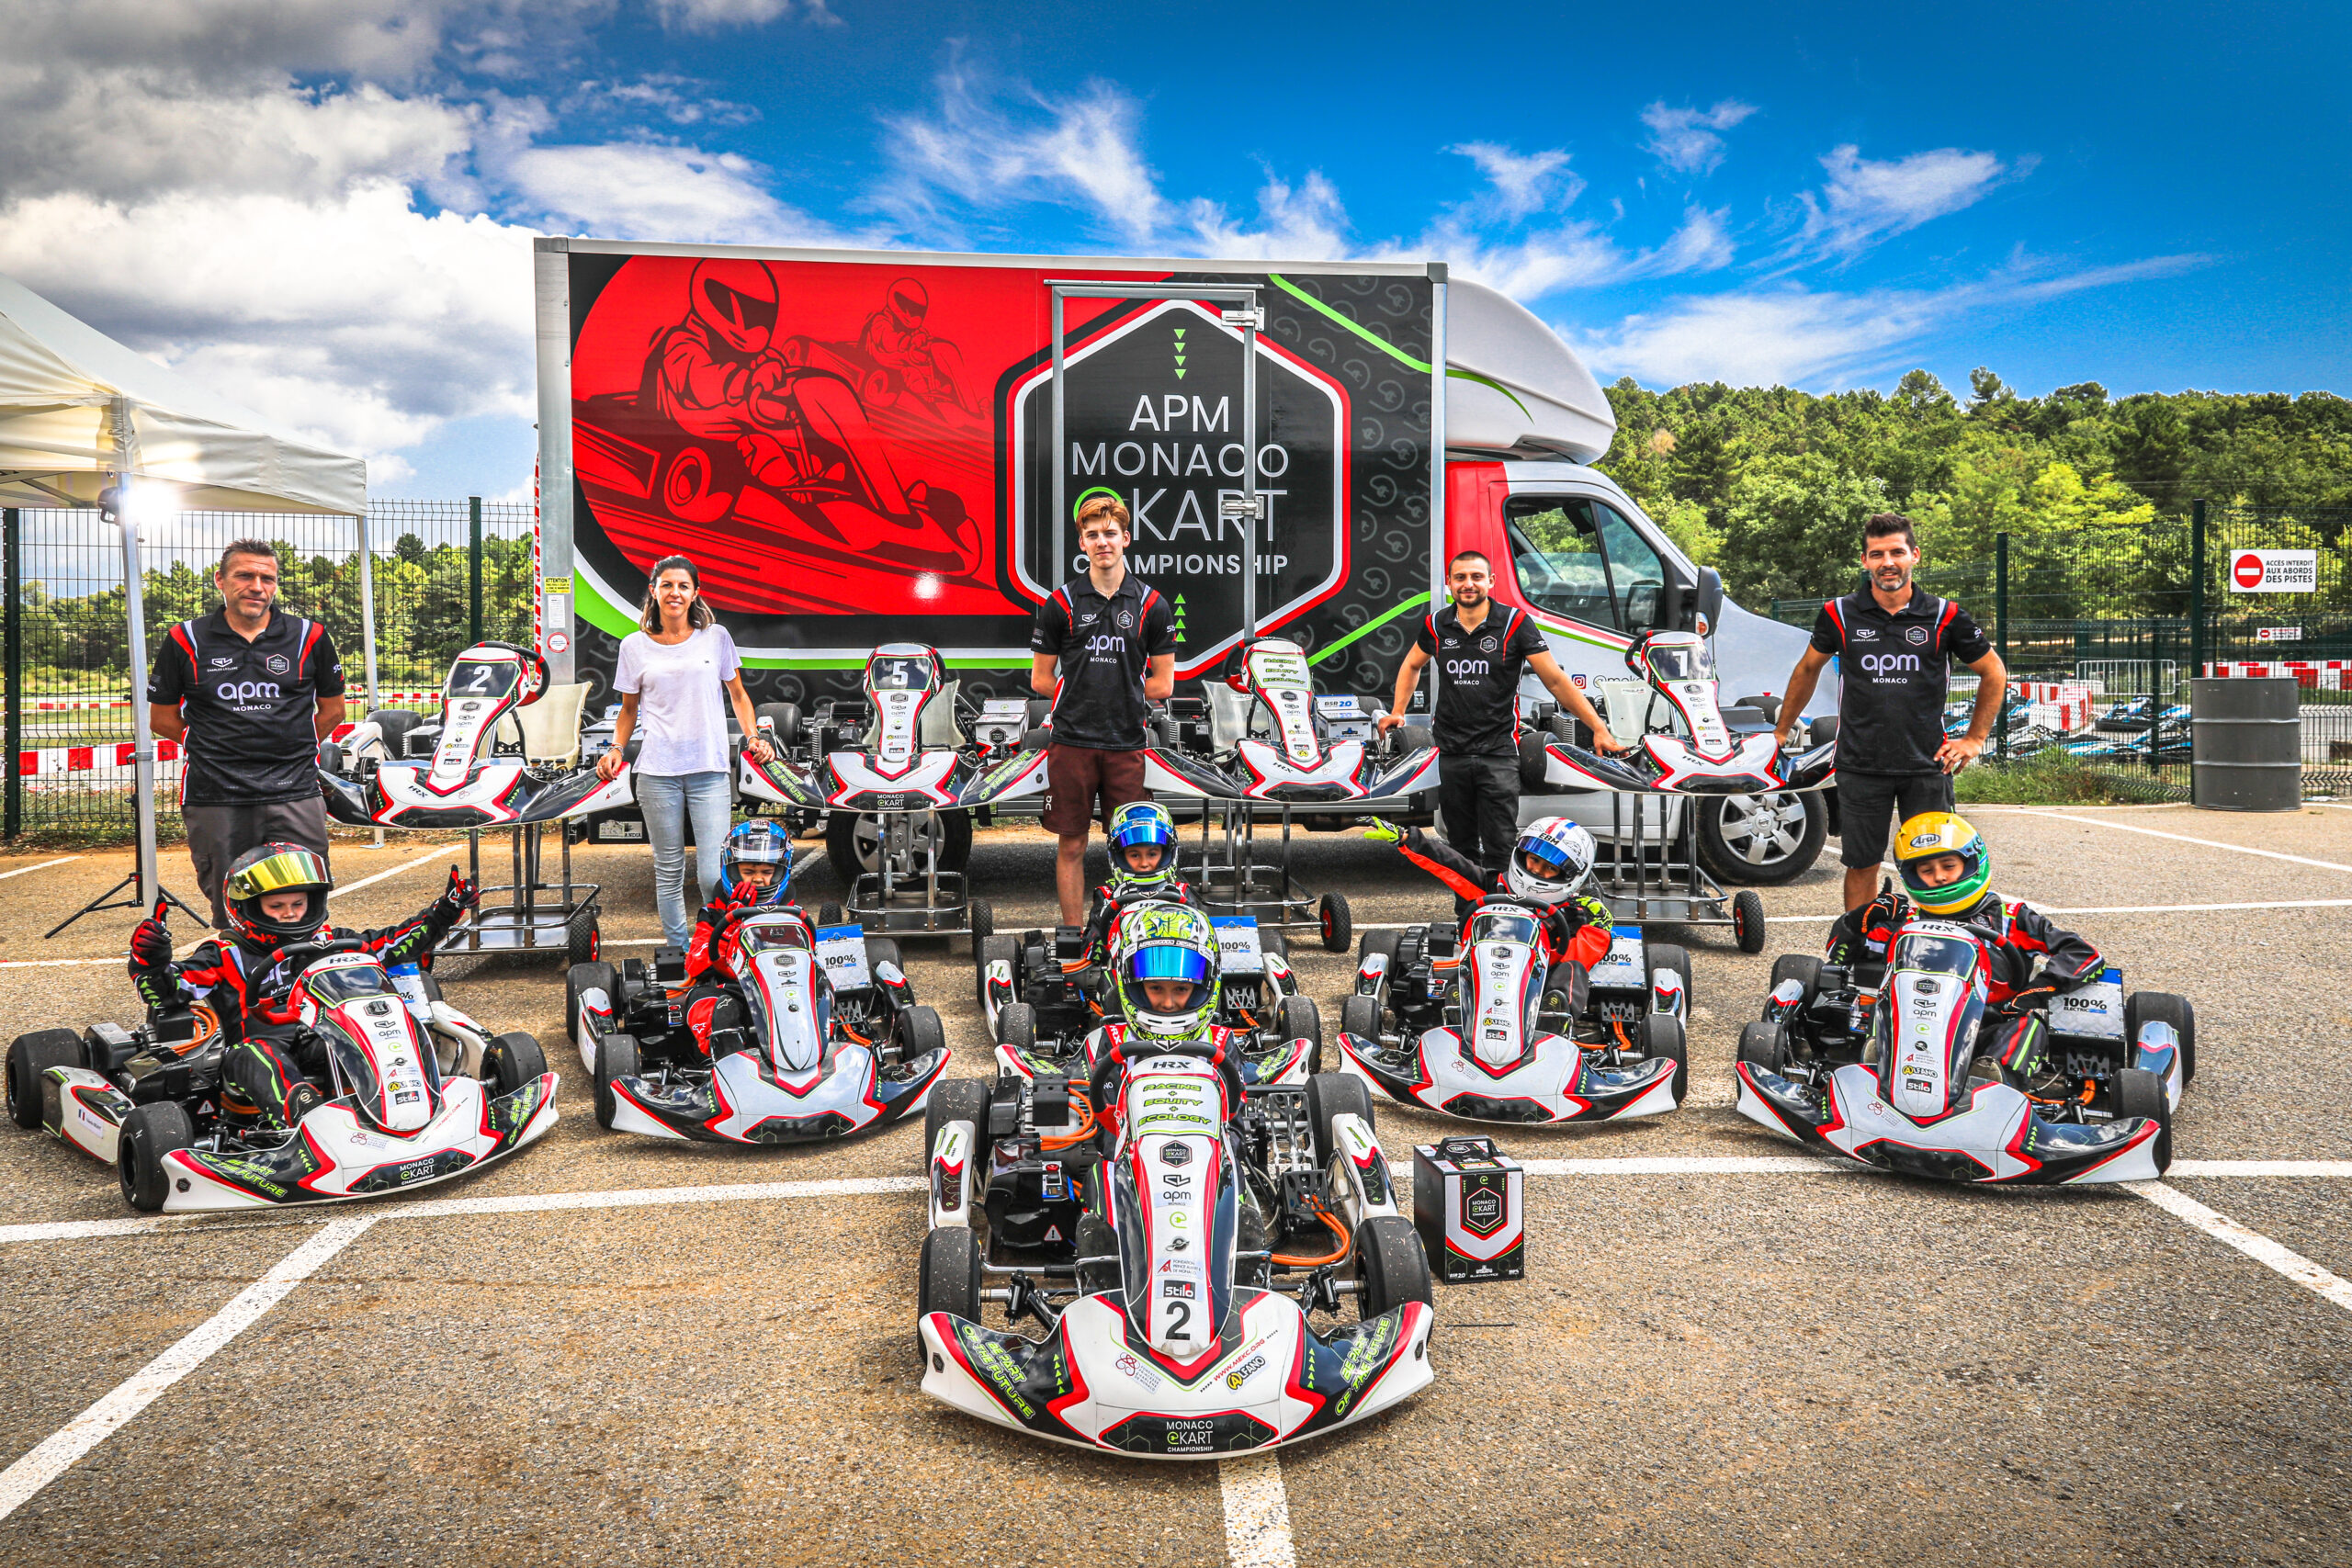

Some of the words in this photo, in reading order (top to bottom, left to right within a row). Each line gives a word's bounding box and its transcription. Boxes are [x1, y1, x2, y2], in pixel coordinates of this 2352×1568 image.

[1128, 394, 1229, 432] APM
[1072, 442, 1289, 478] MONACO
[1084, 634, 1125, 656] apm
[1446, 659, 1489, 679] apm
[1860, 653, 1919, 677] apm
[468, 665, 492, 693] 2
[891, 660, 909, 686] 5
[1263, 677, 1306, 685] ECOLOGY
[217, 681, 280, 705] apm
[232, 704, 271, 712] MONACO
[1273, 761, 1294, 773] HRX
[408, 785, 428, 798] HRX
[1538, 832, 1560, 846] EBM
[1913, 834, 1937, 845] Arai
[1921, 923, 1955, 933] HRX
[1220, 941, 1250, 950] 100%
[329, 955, 361, 964] HRX
[825, 953, 856, 965] 100%
[2064, 997, 2107, 1010] 100%
[1913, 1010, 1937, 1018] apm
[1483, 1017, 1512, 1028] ALFANO
[379, 1029, 401, 1038] apm
[1109, 1025, 1122, 1044] HRX
[1214, 1026, 1228, 1046] HRX
[1152, 1061, 1192, 1069] HRX
[1902, 1065, 1938, 1078] ALFANO
[1142, 1083, 1202, 1092] RACING
[1143, 1098, 1204, 1108] EQUITY
[1137, 1113, 1212, 1128] ECOLOGY
[399, 1158, 435, 1171] MONACO
[235, 1169, 288, 1198] FUTURE
[401, 1174, 435, 1185] CHAMPIONSHIP
[1162, 1190, 1192, 1202] apm
[1165, 1301, 1191, 1340] 2
[1347, 1334, 1370, 1362] PART
[987, 1341, 1004, 1356] BE
[998, 1353, 1026, 1382] PART
[1213, 1338, 1265, 1382] WWW.MEKC.ORG
[1335, 1388, 1351, 1416] OF
[1351, 1361, 1372, 1392] THE
[1364, 1316, 1393, 1363] FUTURE
[962, 1325, 981, 1344] OF
[973, 1342, 994, 1365] THE
[987, 1363, 1035, 1419] FUTURE
[1227, 1355, 1266, 1390] ALFANO
[1340, 1358, 1356, 1382] BE
[1166, 1420, 1214, 1429] MONACO
[1167, 1430, 1214, 1445] eKART
